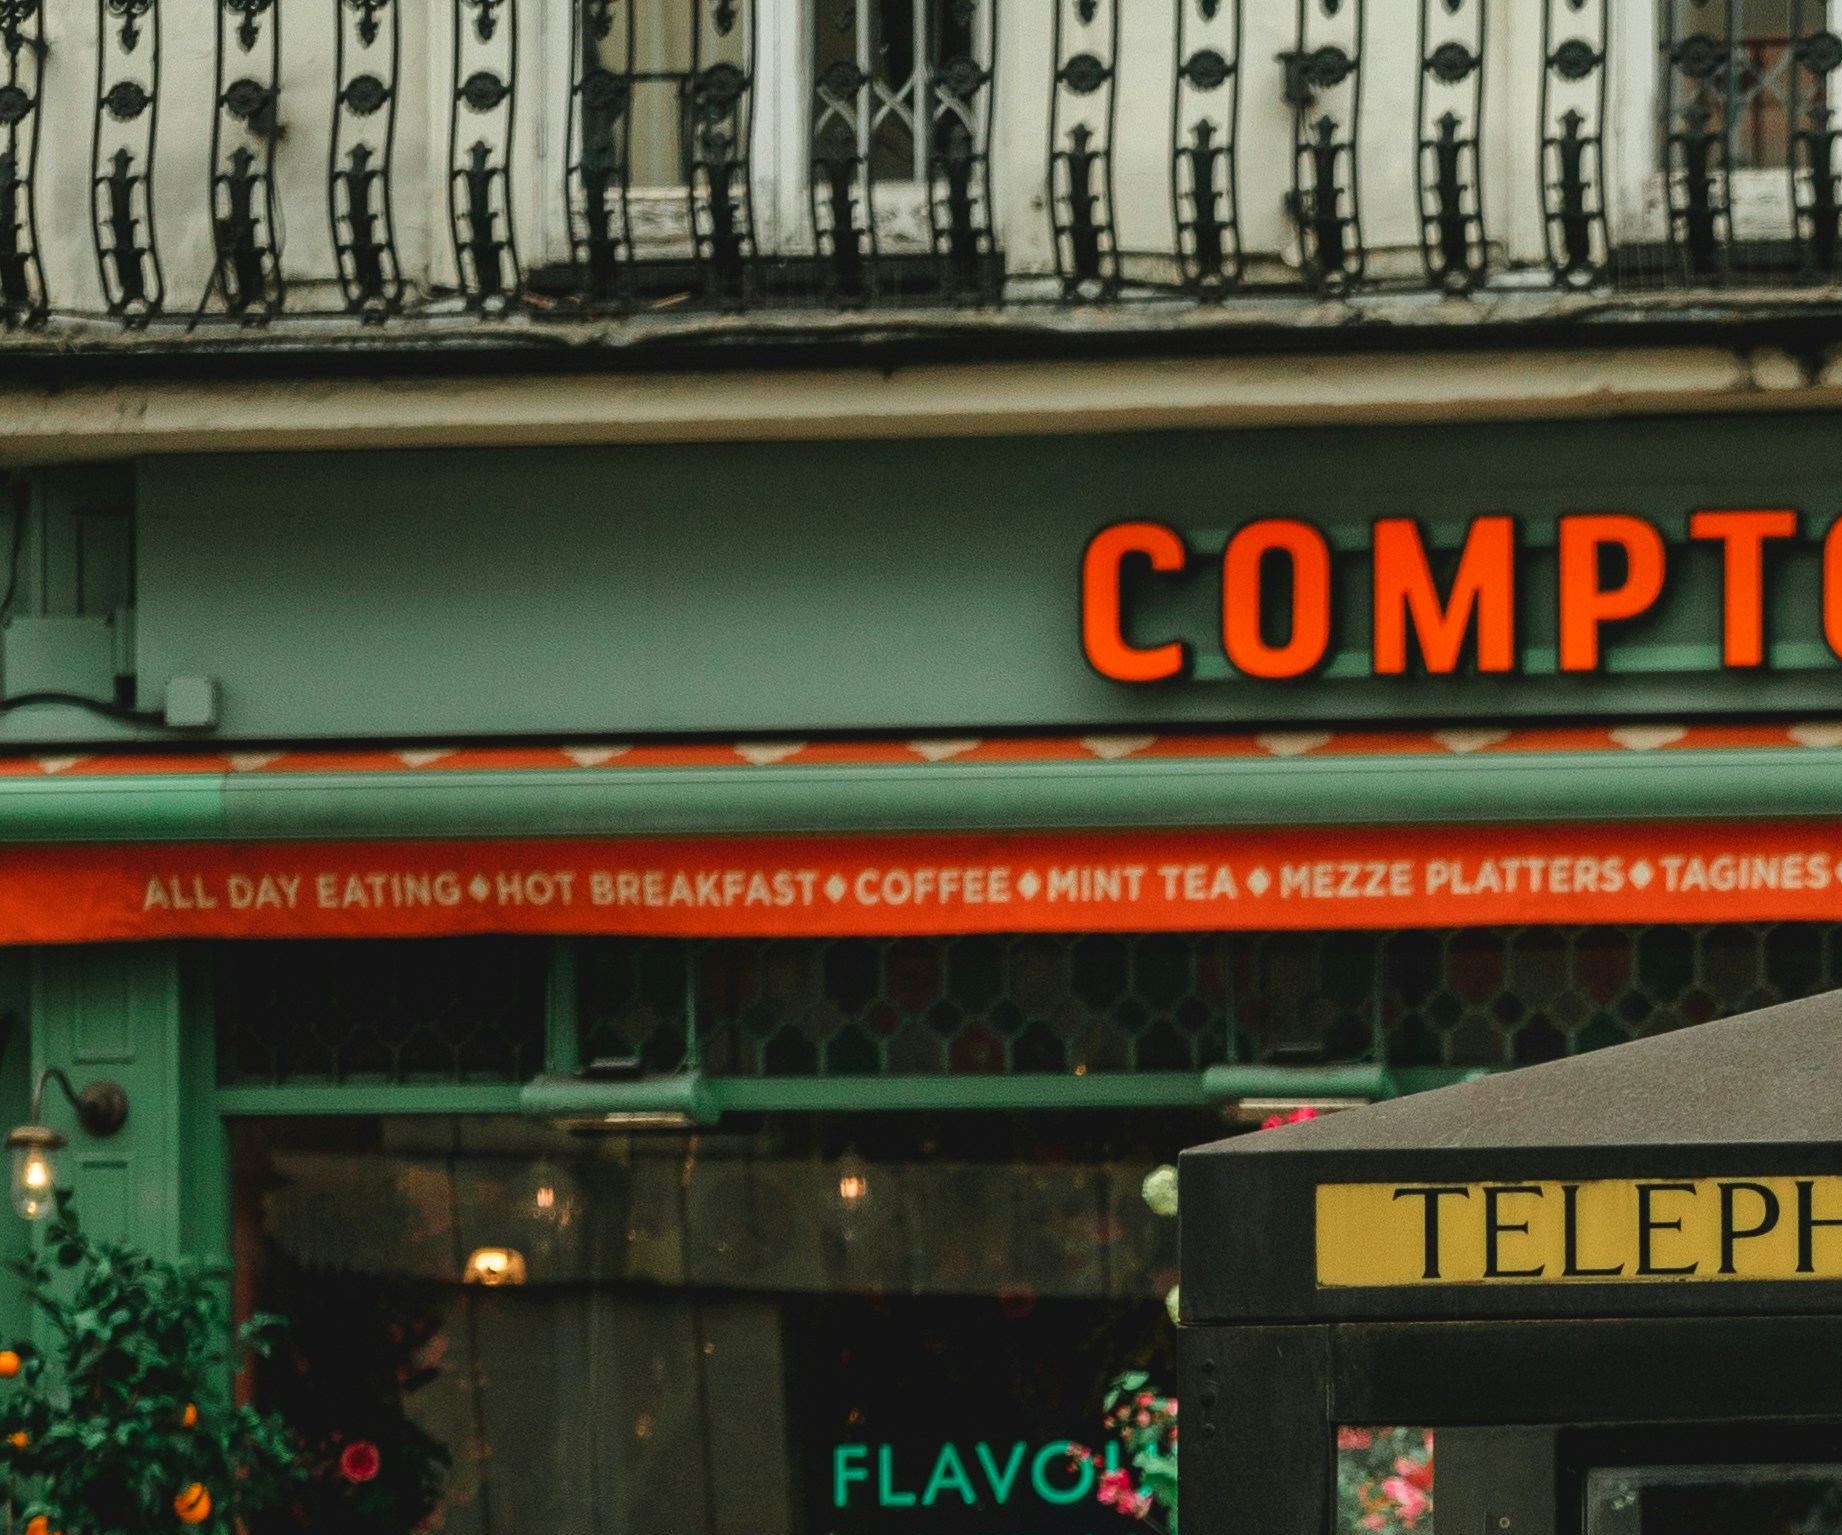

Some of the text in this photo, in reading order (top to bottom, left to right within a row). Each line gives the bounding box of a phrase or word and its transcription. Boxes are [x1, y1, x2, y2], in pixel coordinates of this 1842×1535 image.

[142, 876, 217, 911] ALL
[227, 875, 301, 909] DAY
[315, 873, 462, 909] EATING
[495, 872, 575, 906] HOT
[590, 870, 819, 908] BREAKFAST
[853, 866, 1012, 907] COFFEE
[1045, 864, 1147, 904] MINT
[1157, 863, 1240, 902] TEA
[1279, 860, 1415, 900] MEZZE
[1424, 855, 1626, 897] PLATTERS
[1658, 852, 1833, 893] TAGINES
